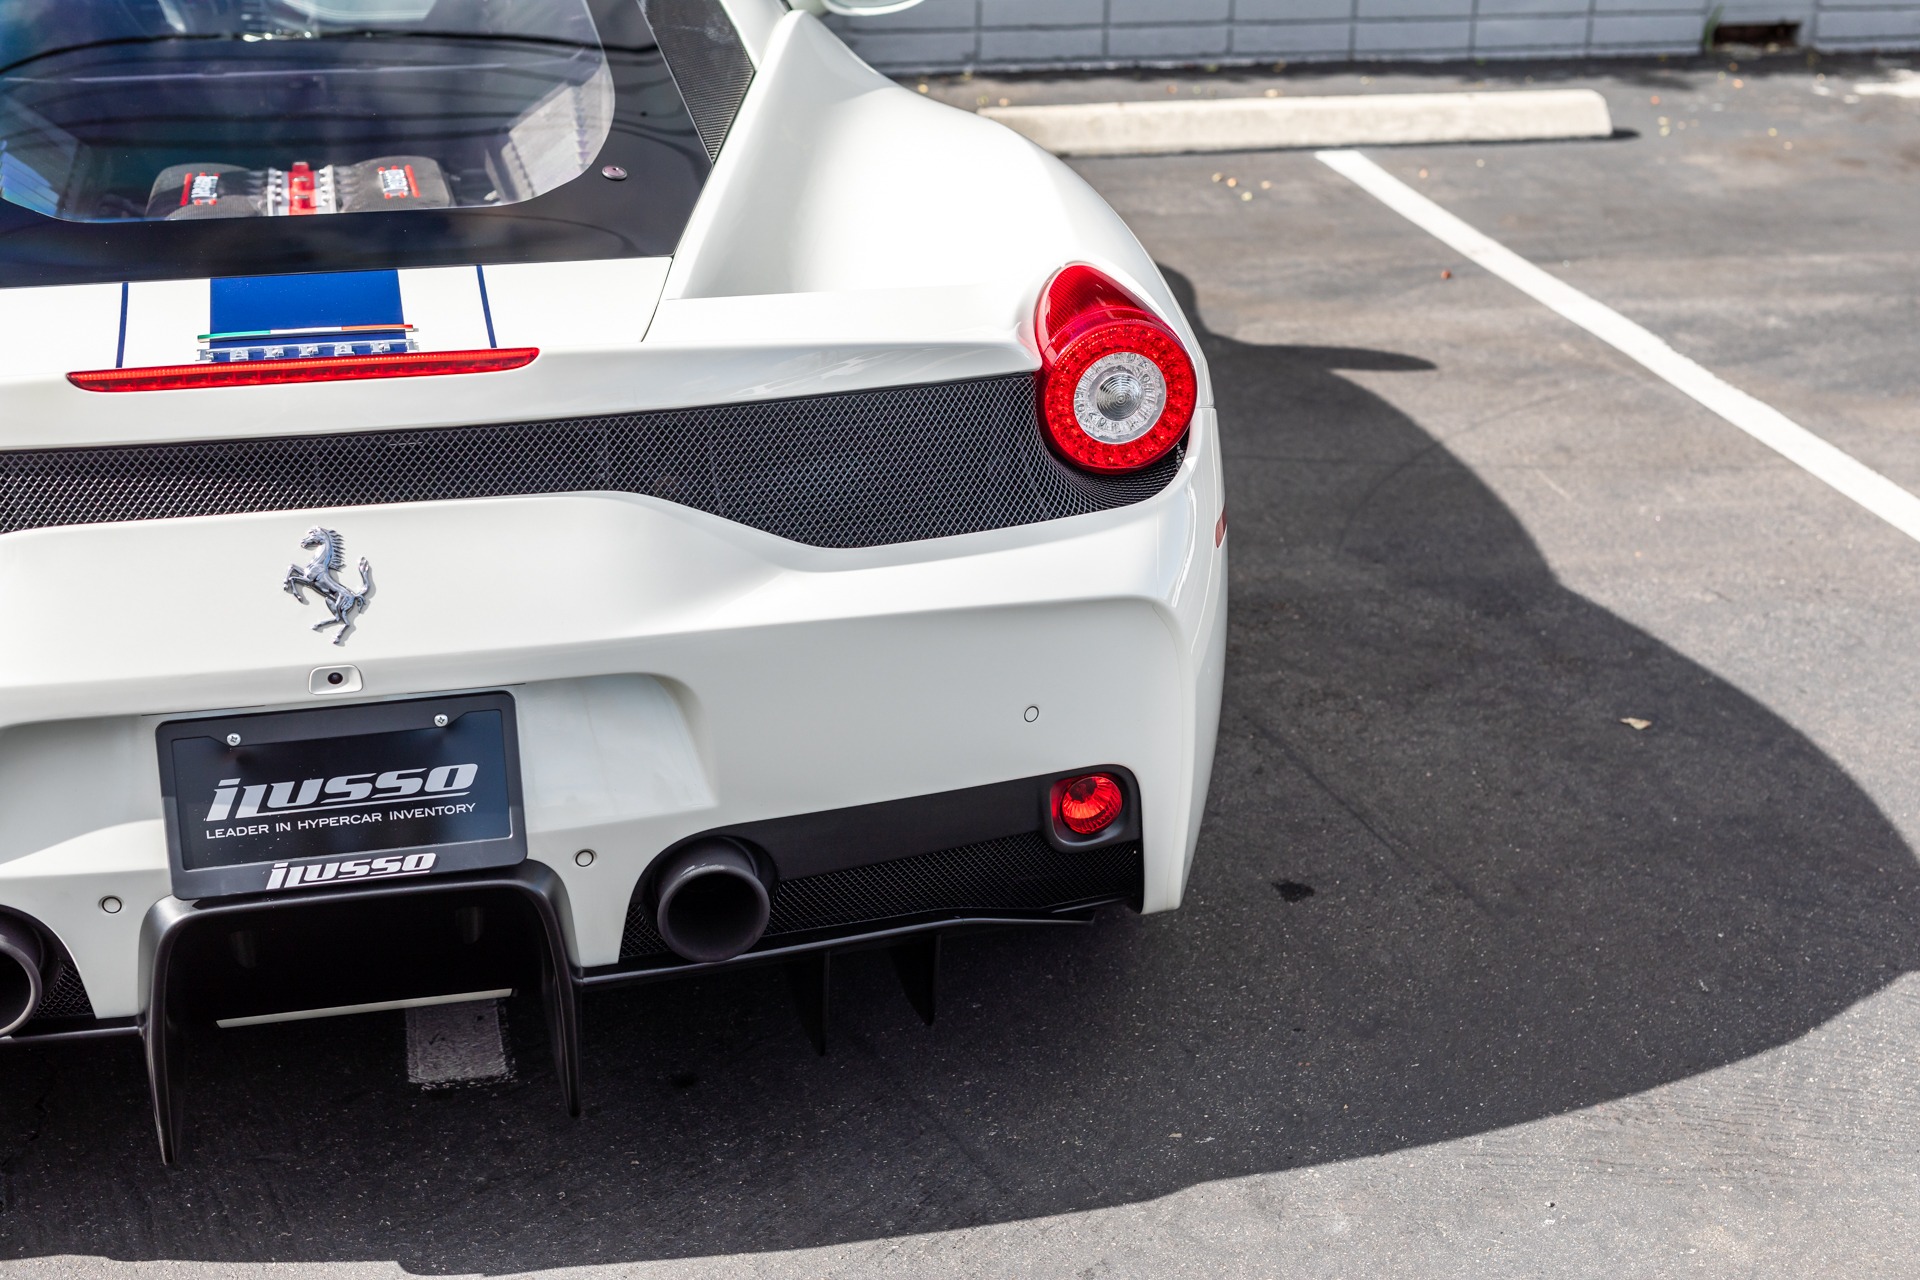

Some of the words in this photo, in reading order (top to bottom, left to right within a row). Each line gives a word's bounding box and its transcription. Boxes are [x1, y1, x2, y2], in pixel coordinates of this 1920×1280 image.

[206, 824, 269, 839] LEADER
[275, 821, 291, 833] IN
[297, 812, 382, 830] HYPERCAR
[389, 802, 476, 821] INVENTORY
